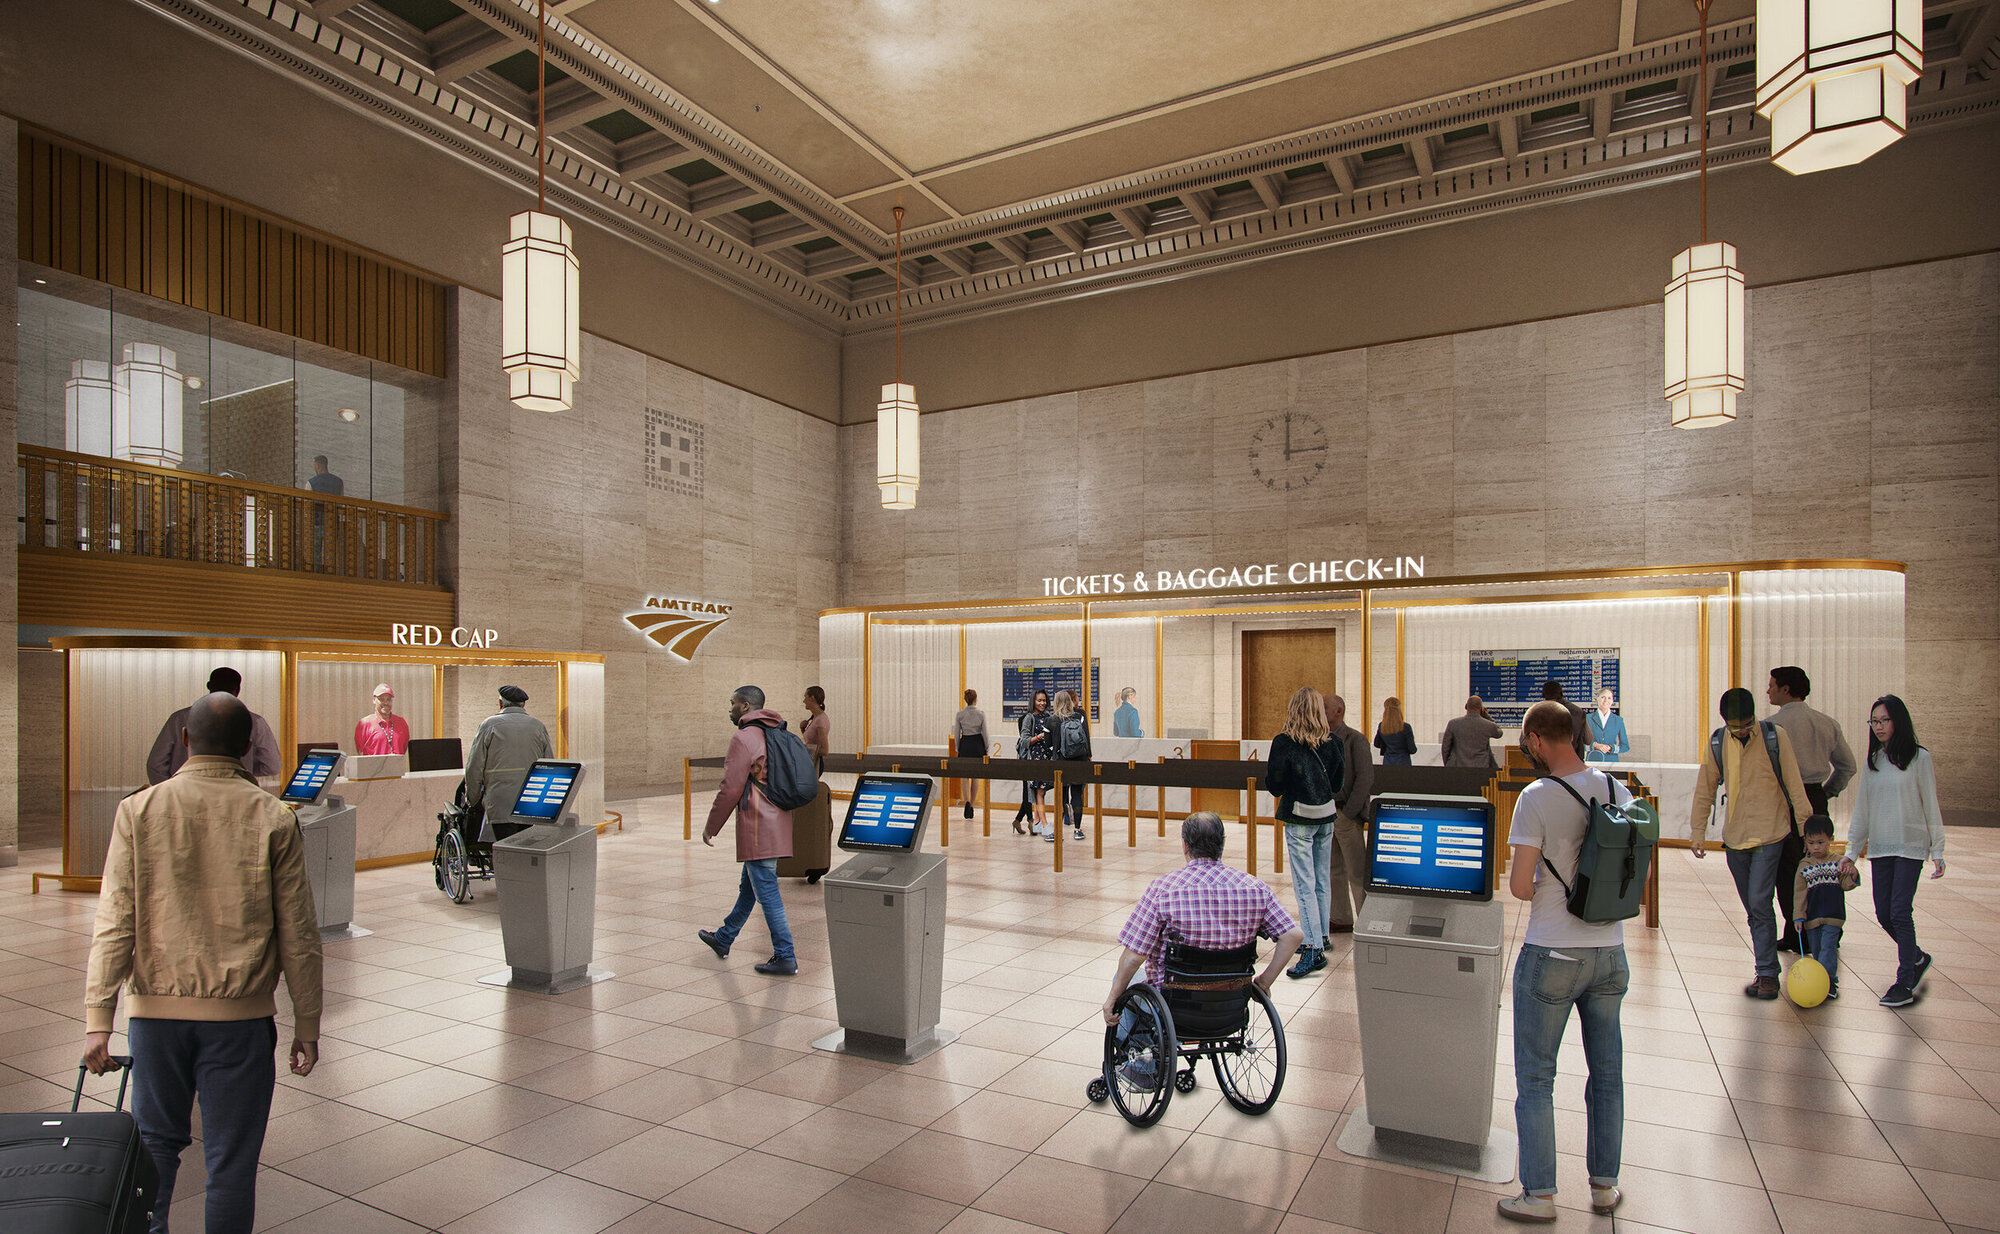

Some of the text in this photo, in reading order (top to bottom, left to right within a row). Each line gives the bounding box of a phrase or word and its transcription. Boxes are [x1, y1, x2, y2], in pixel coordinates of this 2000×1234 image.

[1042, 556, 1424, 596] TICKETS & BAGGAGE CHECK-IN
[646, 598, 730, 615] AMTRAK
[392, 623, 498, 649] RED CAP
[993, 742, 1002, 758] 2
[1173, 746, 1184, 760] 3
